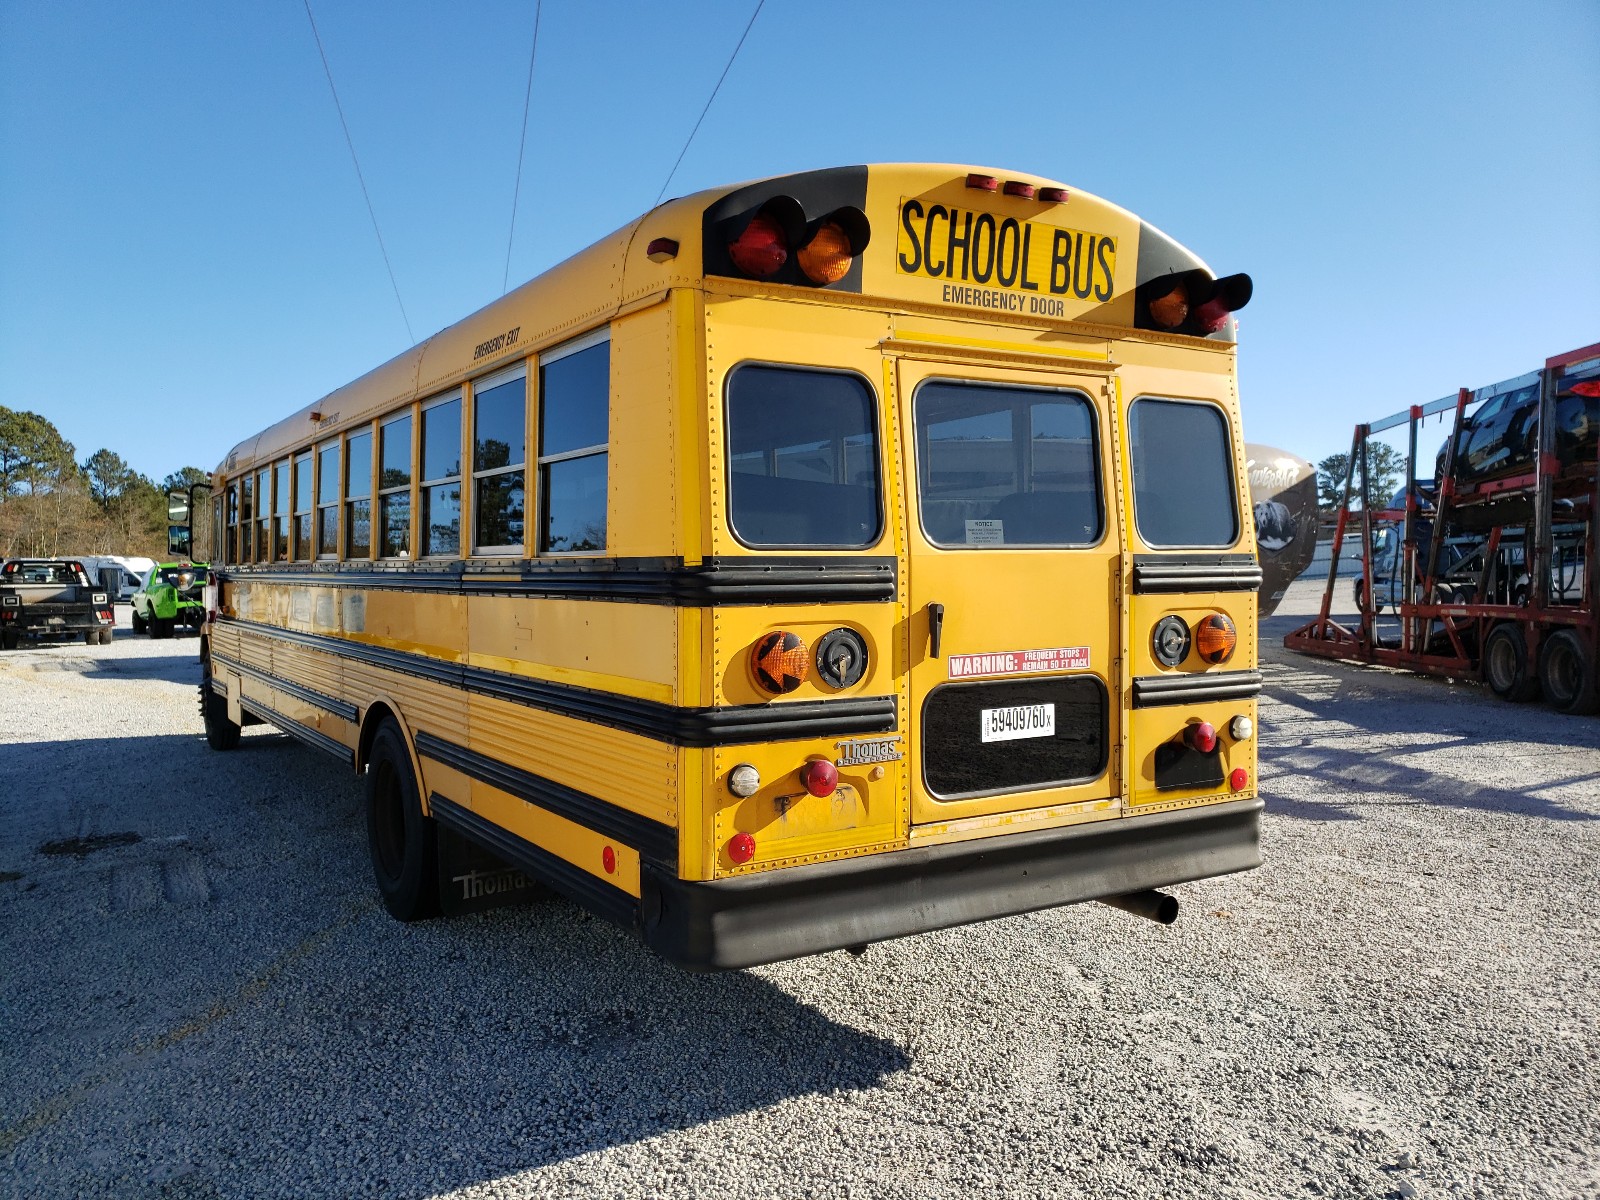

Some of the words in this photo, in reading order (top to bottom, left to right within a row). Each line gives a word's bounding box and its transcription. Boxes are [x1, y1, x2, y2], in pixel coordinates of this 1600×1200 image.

[898, 199, 1040, 292] SCHOOL
[1050, 228, 1115, 303] BUS
[942, 284, 1025, 312] EMERGENCY
[1030, 297, 1065, 317] DOOR
[473, 333, 506, 360] EMERGENCY
[506, 326, 521, 347] EXIT
[951, 656, 1018, 675] WARNING:
[1022, 660, 1049, 671] REMAIN
[1050, 660, 1059, 669] 50
[1061, 659, 1070, 668] FT
[1070, 657, 1088, 668] BACK
[1024, 650, 1058, 661] FREQUENT
[991, 706, 1045, 732] 59409760
[838, 736, 902, 759] Thomas
